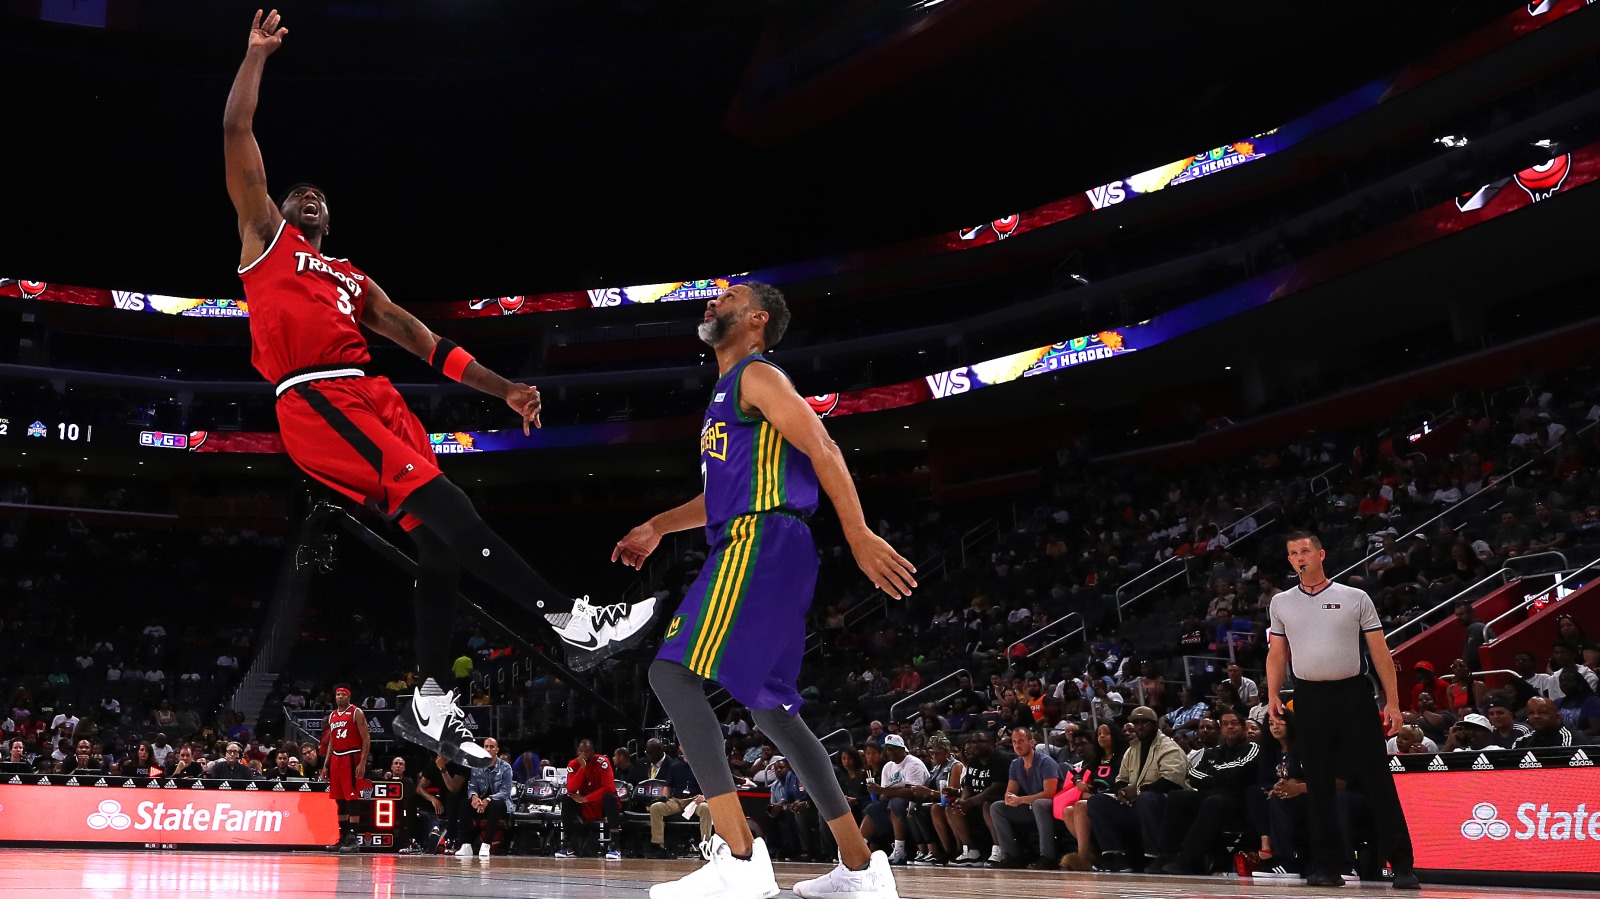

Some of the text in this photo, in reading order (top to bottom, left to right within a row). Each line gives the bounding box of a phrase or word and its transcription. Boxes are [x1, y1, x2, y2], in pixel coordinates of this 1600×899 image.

[1192, 154, 1246, 177] 3 HEADED
[1085, 180, 1126, 210] VS
[294, 251, 363, 297] TRILOGY
[111, 289, 146, 311] VS
[587, 287, 622, 308] VS
[679, 291, 686, 299] 3
[208, 308, 243, 316] HEADED
[1049, 346, 1113, 369] 3 HEADED
[925, 366, 971, 399] VS
[58, 422, 79, 441] 10
[1471, 762, 1495, 770] adidas
[1518, 761, 1543, 769] adidas
[1568, 758, 1594, 767] adidas
[376, 799, 393, 827] 8
[1514, 802, 1600, 841] State
